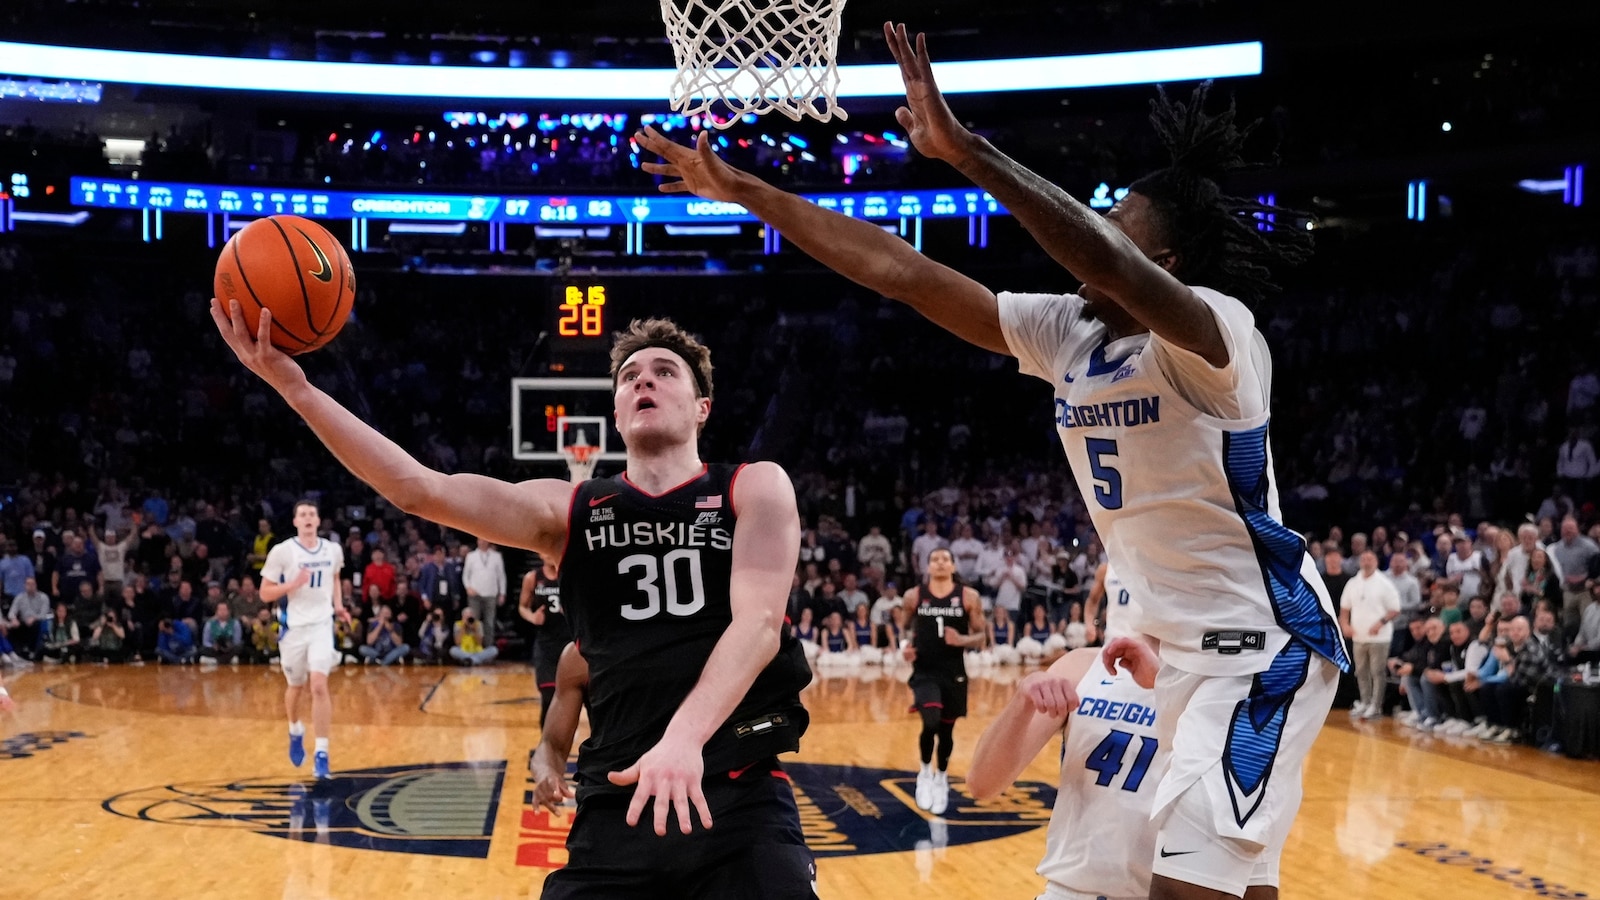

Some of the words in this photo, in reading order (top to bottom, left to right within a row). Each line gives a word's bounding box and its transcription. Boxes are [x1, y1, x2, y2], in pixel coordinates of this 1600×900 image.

[352, 198, 450, 214] CREIGHTON
[566, 286, 606, 305] 8:15
[559, 304, 602, 336] 28
[1085, 437, 1122, 510] 5
[590, 513, 615, 522] CHANGE
[592, 508, 601, 516] BE
[602, 506, 613, 515] THE
[585, 521, 732, 551] HUSKIES
[310, 570, 322, 588] 11
[617, 548, 706, 621] 30
[547, 595, 560, 613] 3
[917, 606, 963, 617] HUSKIES
[935, 616, 944, 638] 1
[1244, 635, 1256, 644] 46
[1085, 728, 1159, 793] 41
